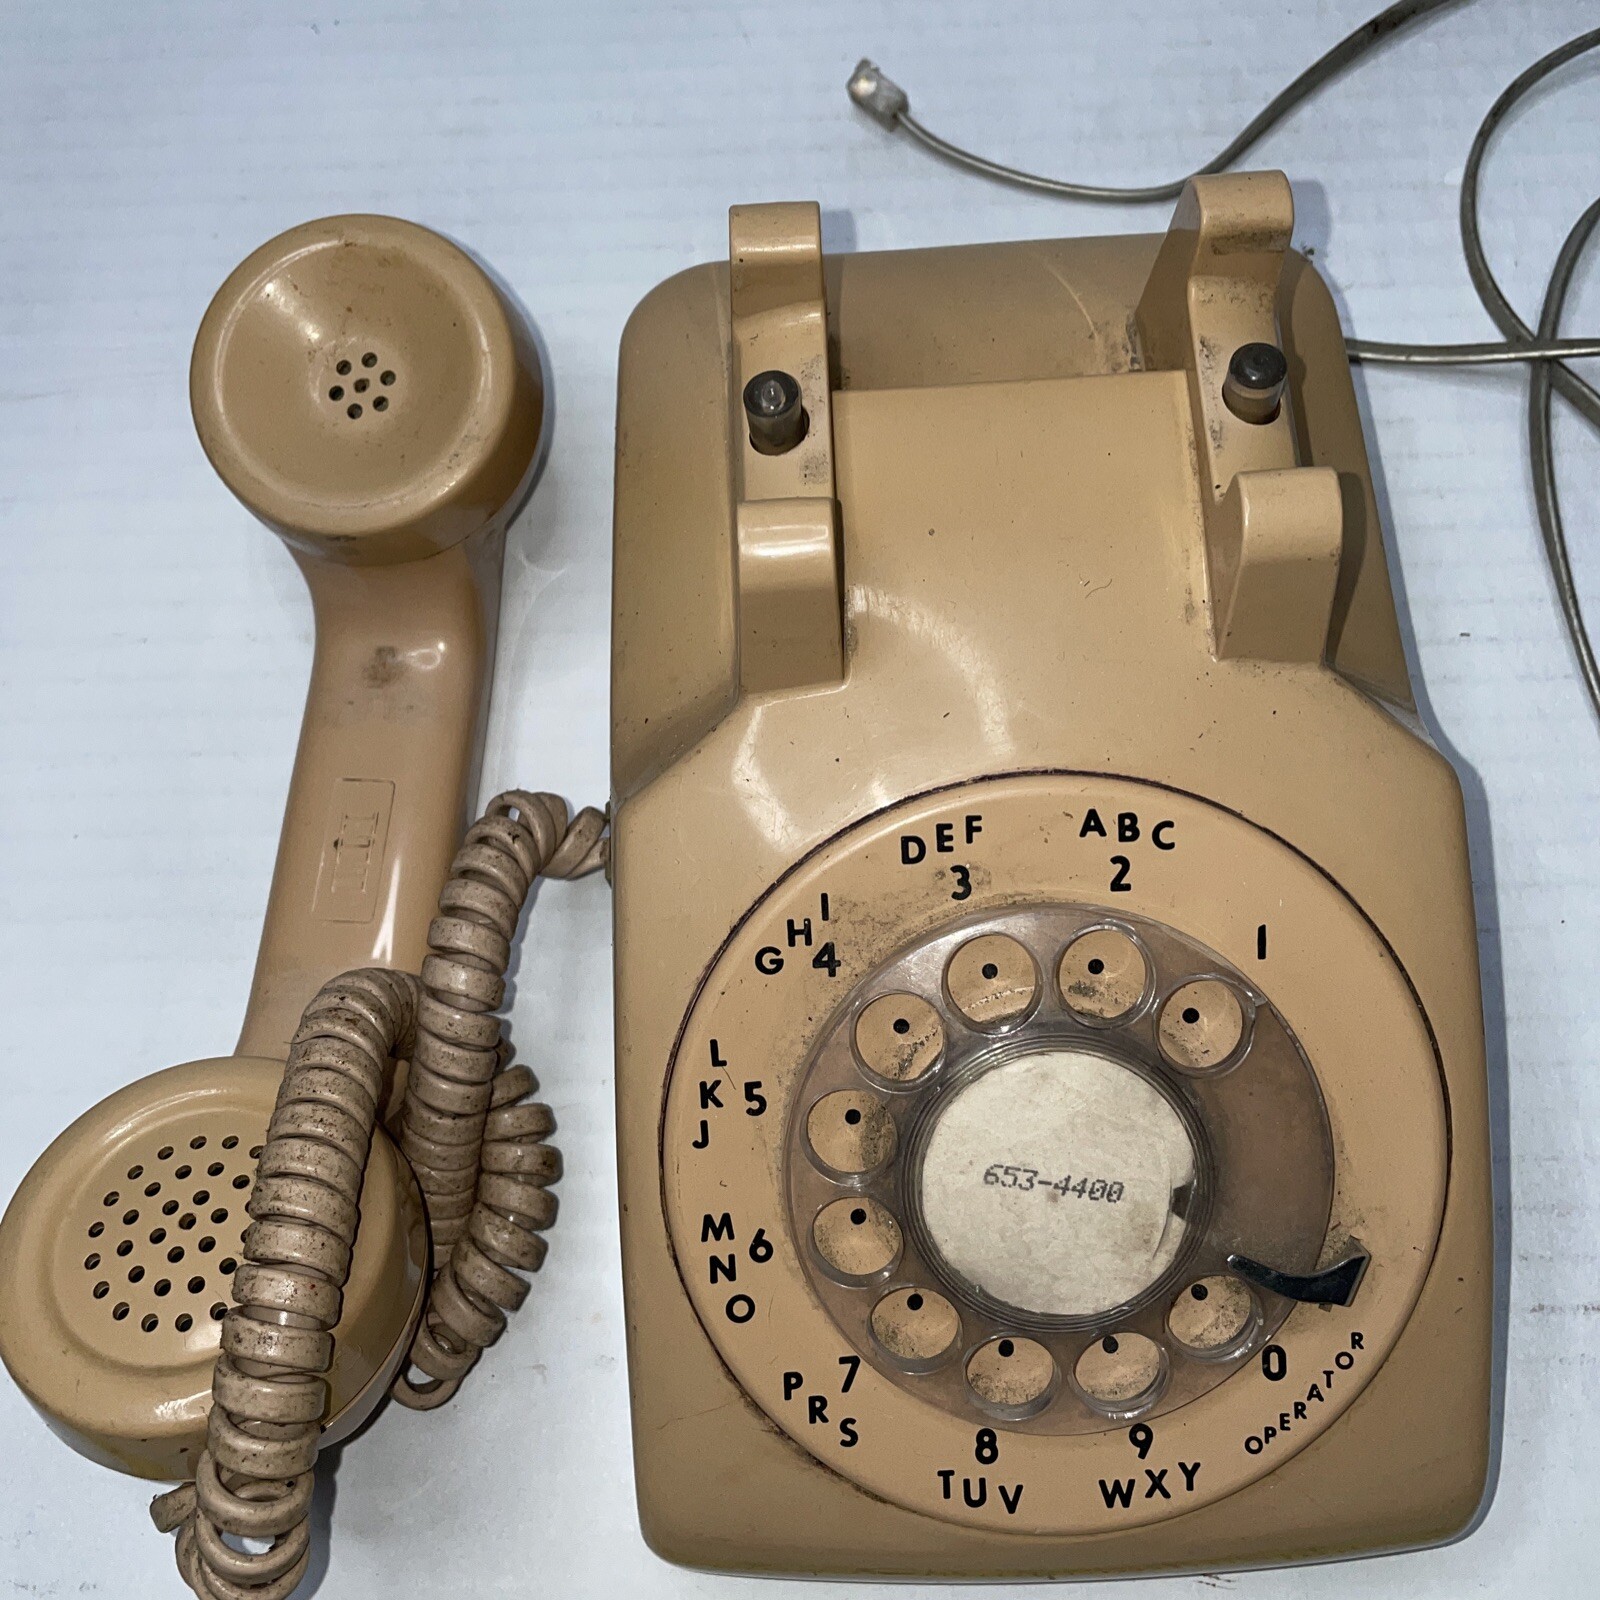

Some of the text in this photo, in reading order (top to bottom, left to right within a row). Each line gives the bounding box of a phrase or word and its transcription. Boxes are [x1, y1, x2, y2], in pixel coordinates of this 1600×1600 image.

[950, 864, 972, 901] 3
[1109, 855, 1132, 892] 2
[812, 942, 842, 978] 4
[744, 1080, 767, 1117] 5
[983, 1164, 1125, 1204] 653-4400
[748, 1228, 774, 1264] 6
[838, 1355, 861, 1393] 7
[1261, 1344, 1287, 1382] 0
[1244, 1332, 1364, 1455] OPERATOR
[974, 1427, 999, 1465] 8
[1128, 1422, 1154, 1460] 9
[1098, 1461, 1201, 1509] WXY
